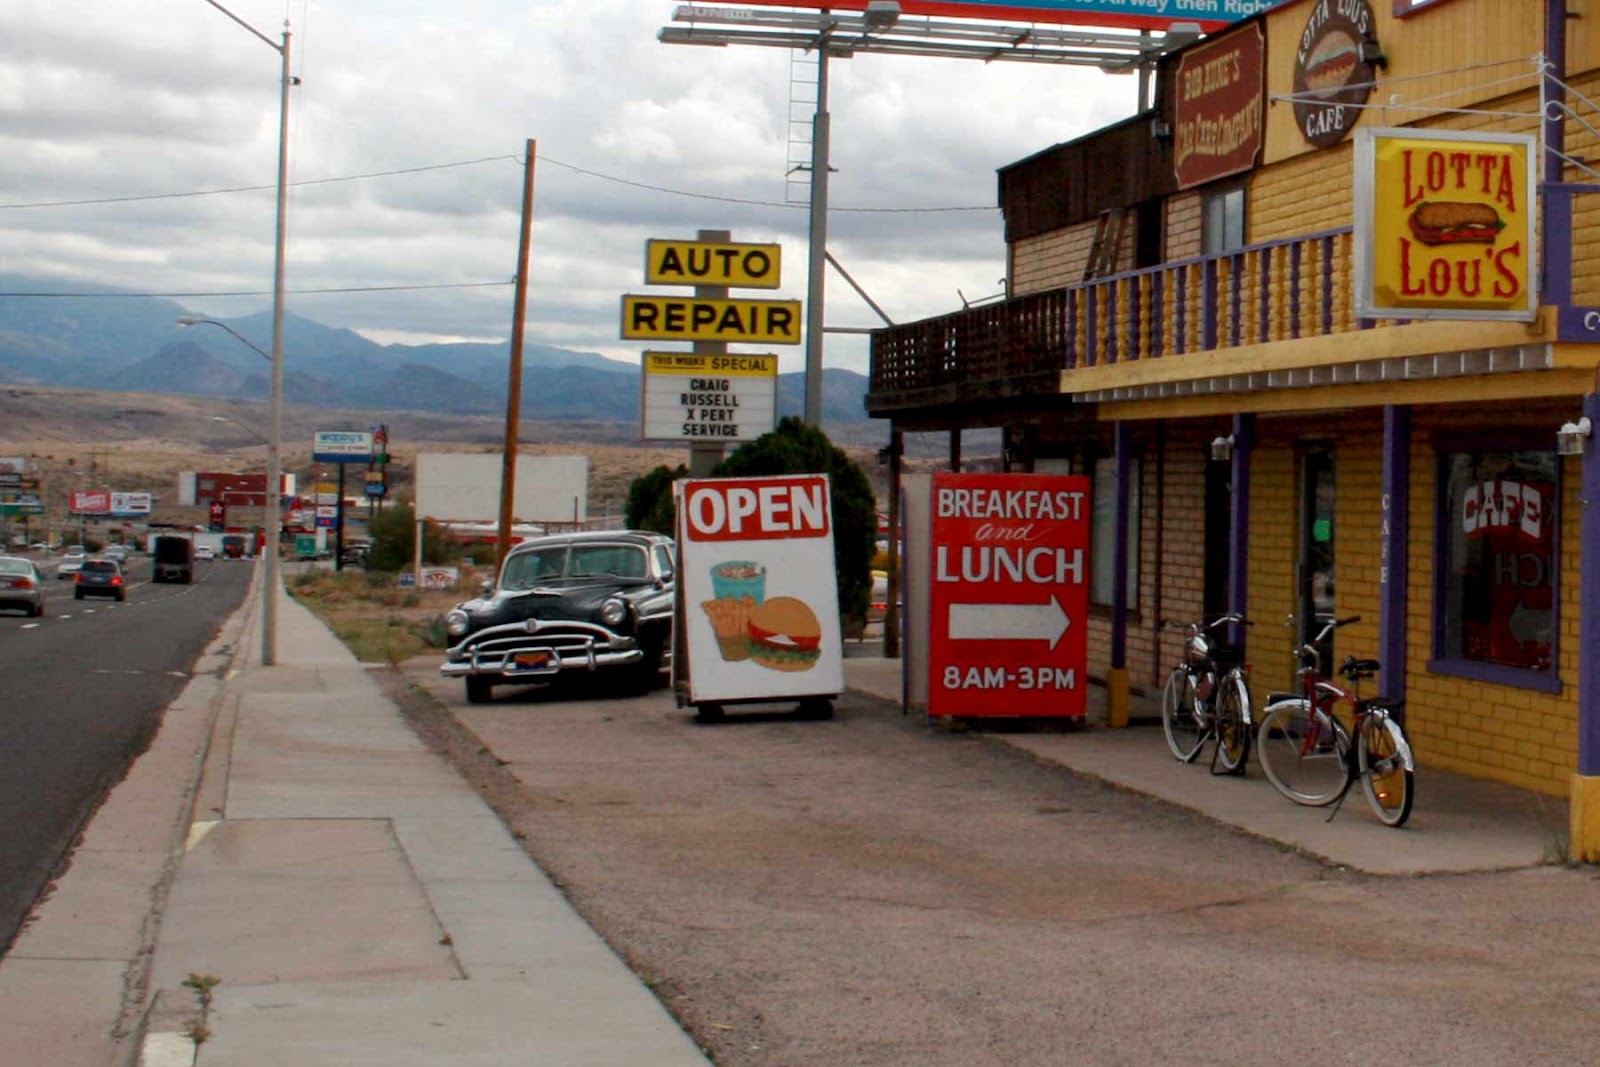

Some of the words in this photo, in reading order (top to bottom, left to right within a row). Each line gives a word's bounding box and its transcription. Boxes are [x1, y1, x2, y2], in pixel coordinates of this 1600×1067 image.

[1100, 0, 1167, 13] way
[1176, 0, 1218, 11] then
[1306, 106, 1344, 137] CAFE
[1402, 150, 1516, 213] LOTTA
[658, 247, 771, 278] AUTO
[1399, 237, 1521, 298] LOU'S
[632, 302, 793, 336] REPAIR
[652, 355, 673, 365] THIS
[712, 357, 769, 371] SPECIAL
[681, 393, 739, 407] RUSSELL
[690, 378, 729, 391] CRAIG
[683, 423, 739, 436] SERVICE
[687, 408, 695, 421] X
[701, 409, 734, 421] PERT
[688, 484, 823, 534] OPEN
[938, 488, 1085, 521] BREAKFAST
[1462, 480, 1541, 539] CAFE
[974, 523, 1050, 541] and
[936, 546, 1084, 584] LUNCH
[943, 666, 1076, 691] 8AM-3PM
